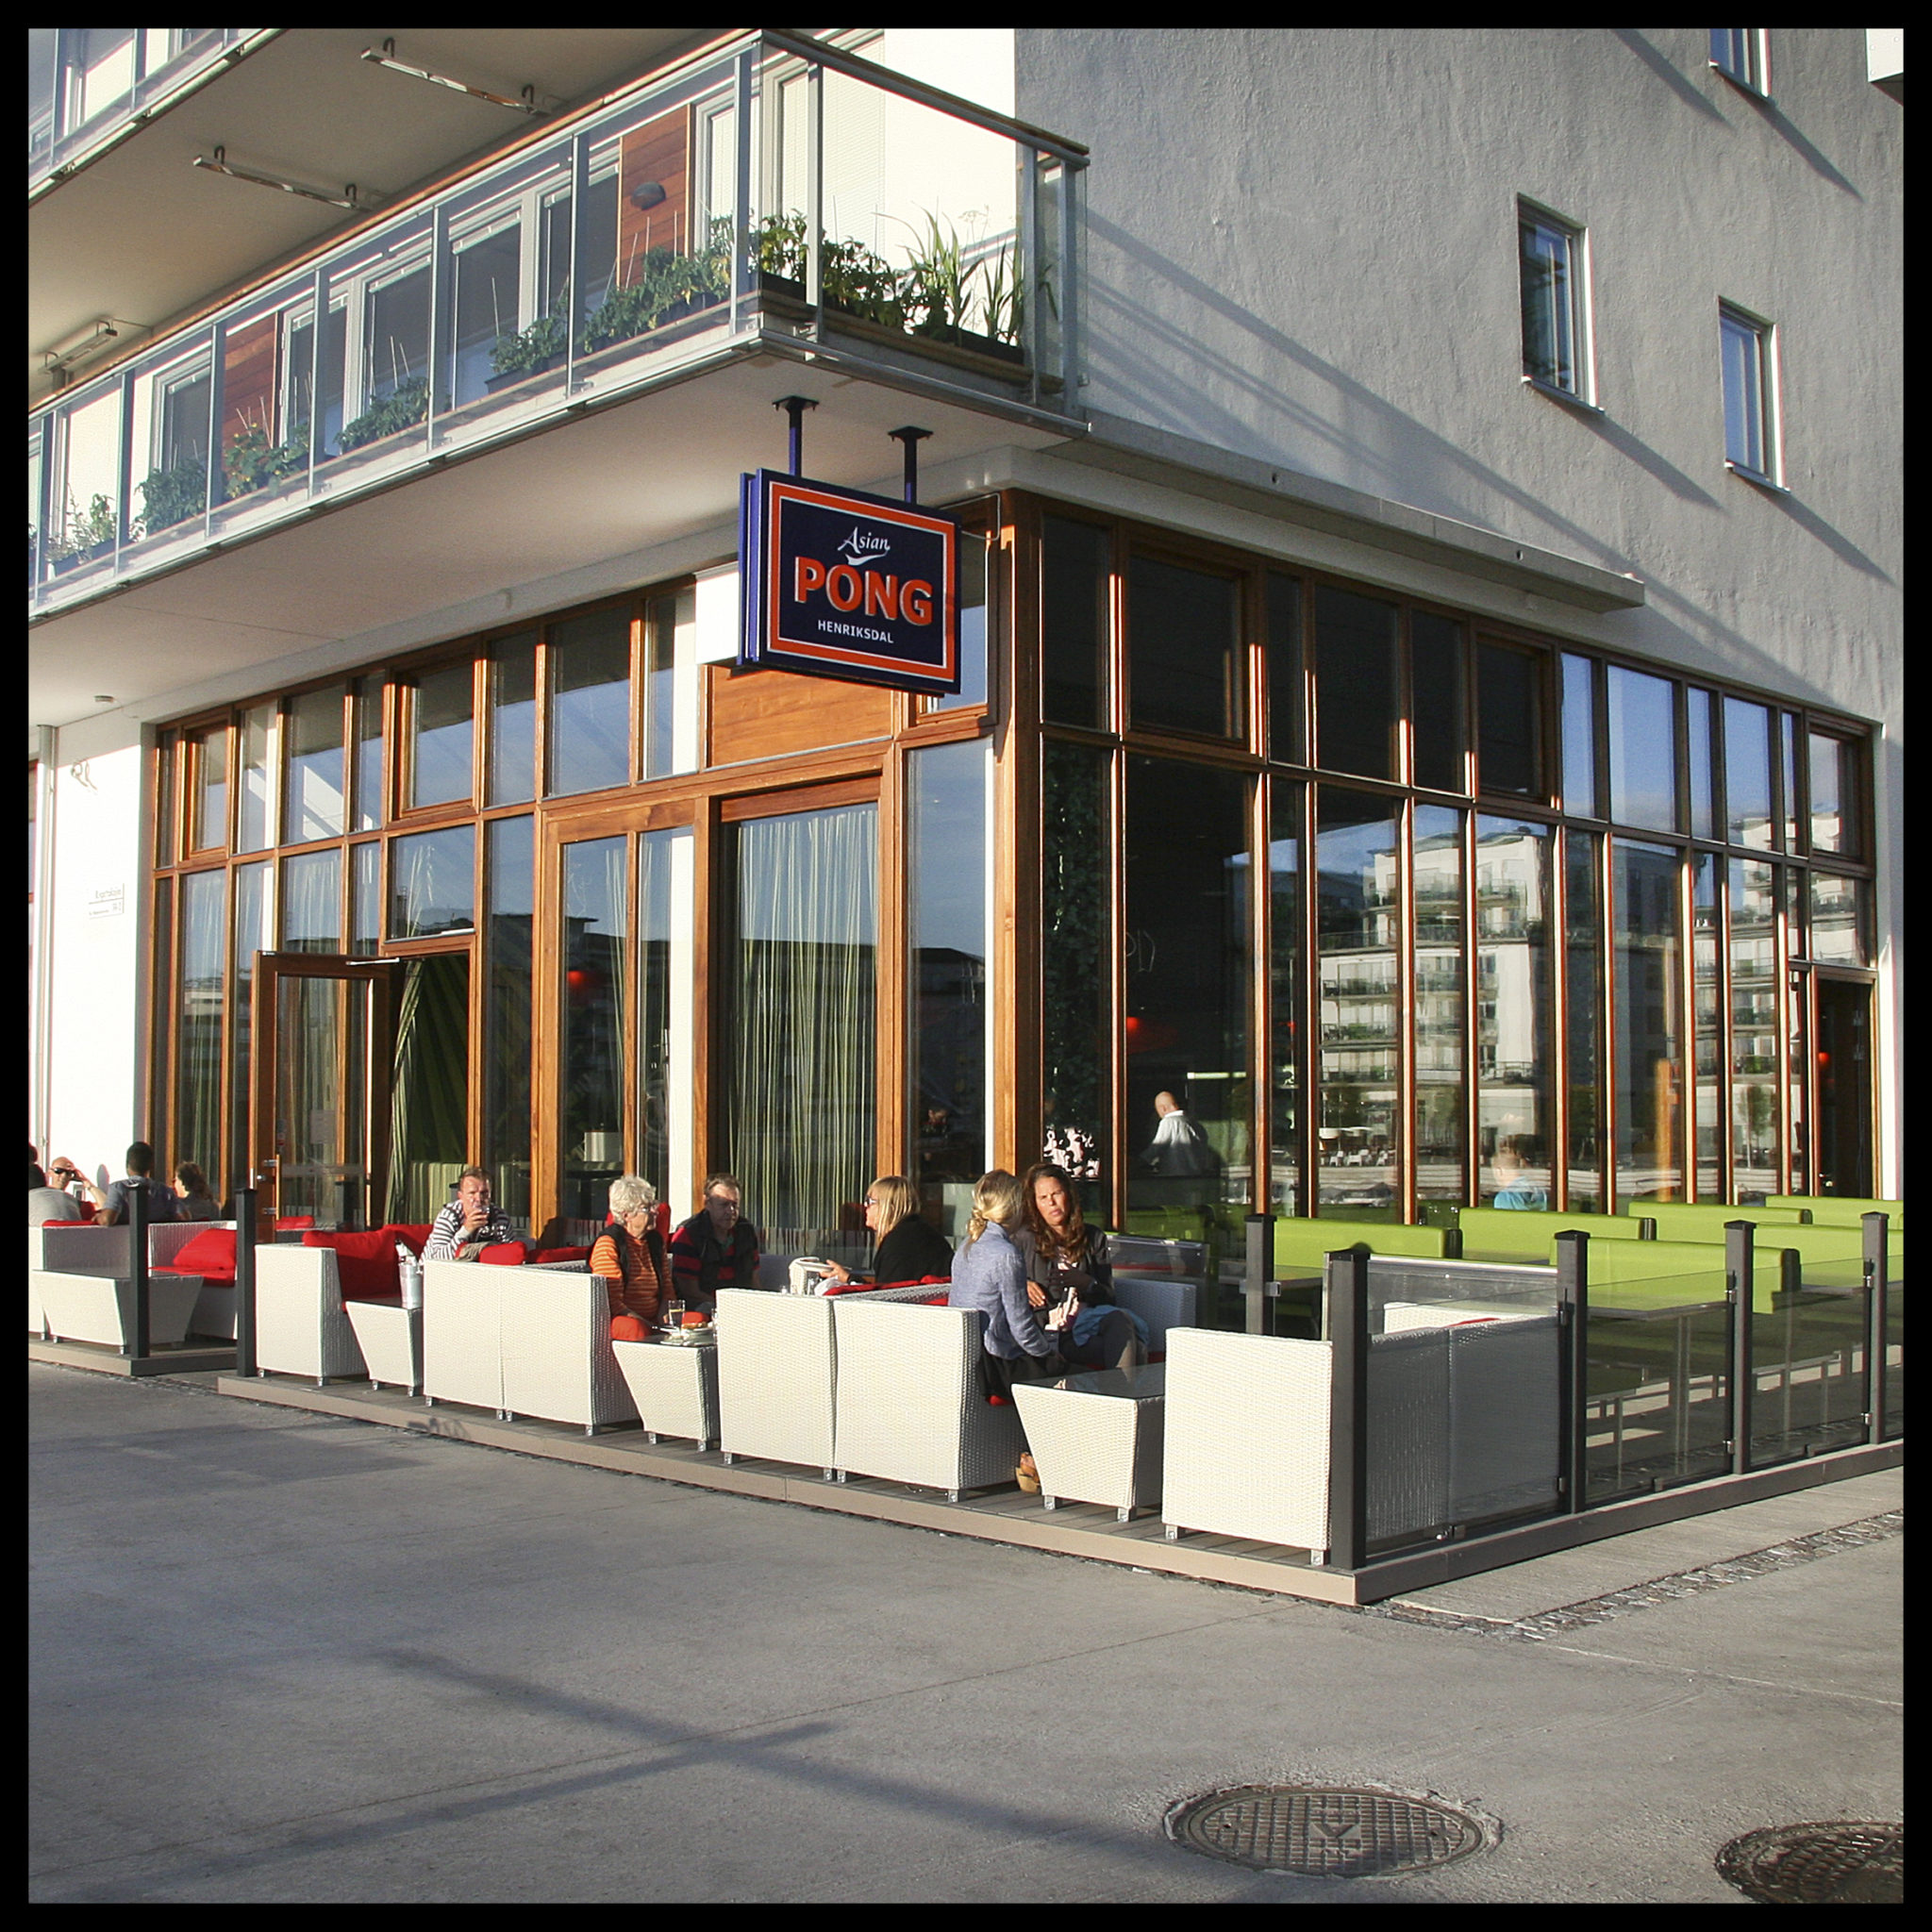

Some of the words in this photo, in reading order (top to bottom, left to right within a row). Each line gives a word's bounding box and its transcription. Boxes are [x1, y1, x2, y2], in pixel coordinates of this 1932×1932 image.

[838, 526, 891, 565] Asian
[795, 557, 933, 625] PONG
[818, 620, 893, 643] HENRIKSDAL
